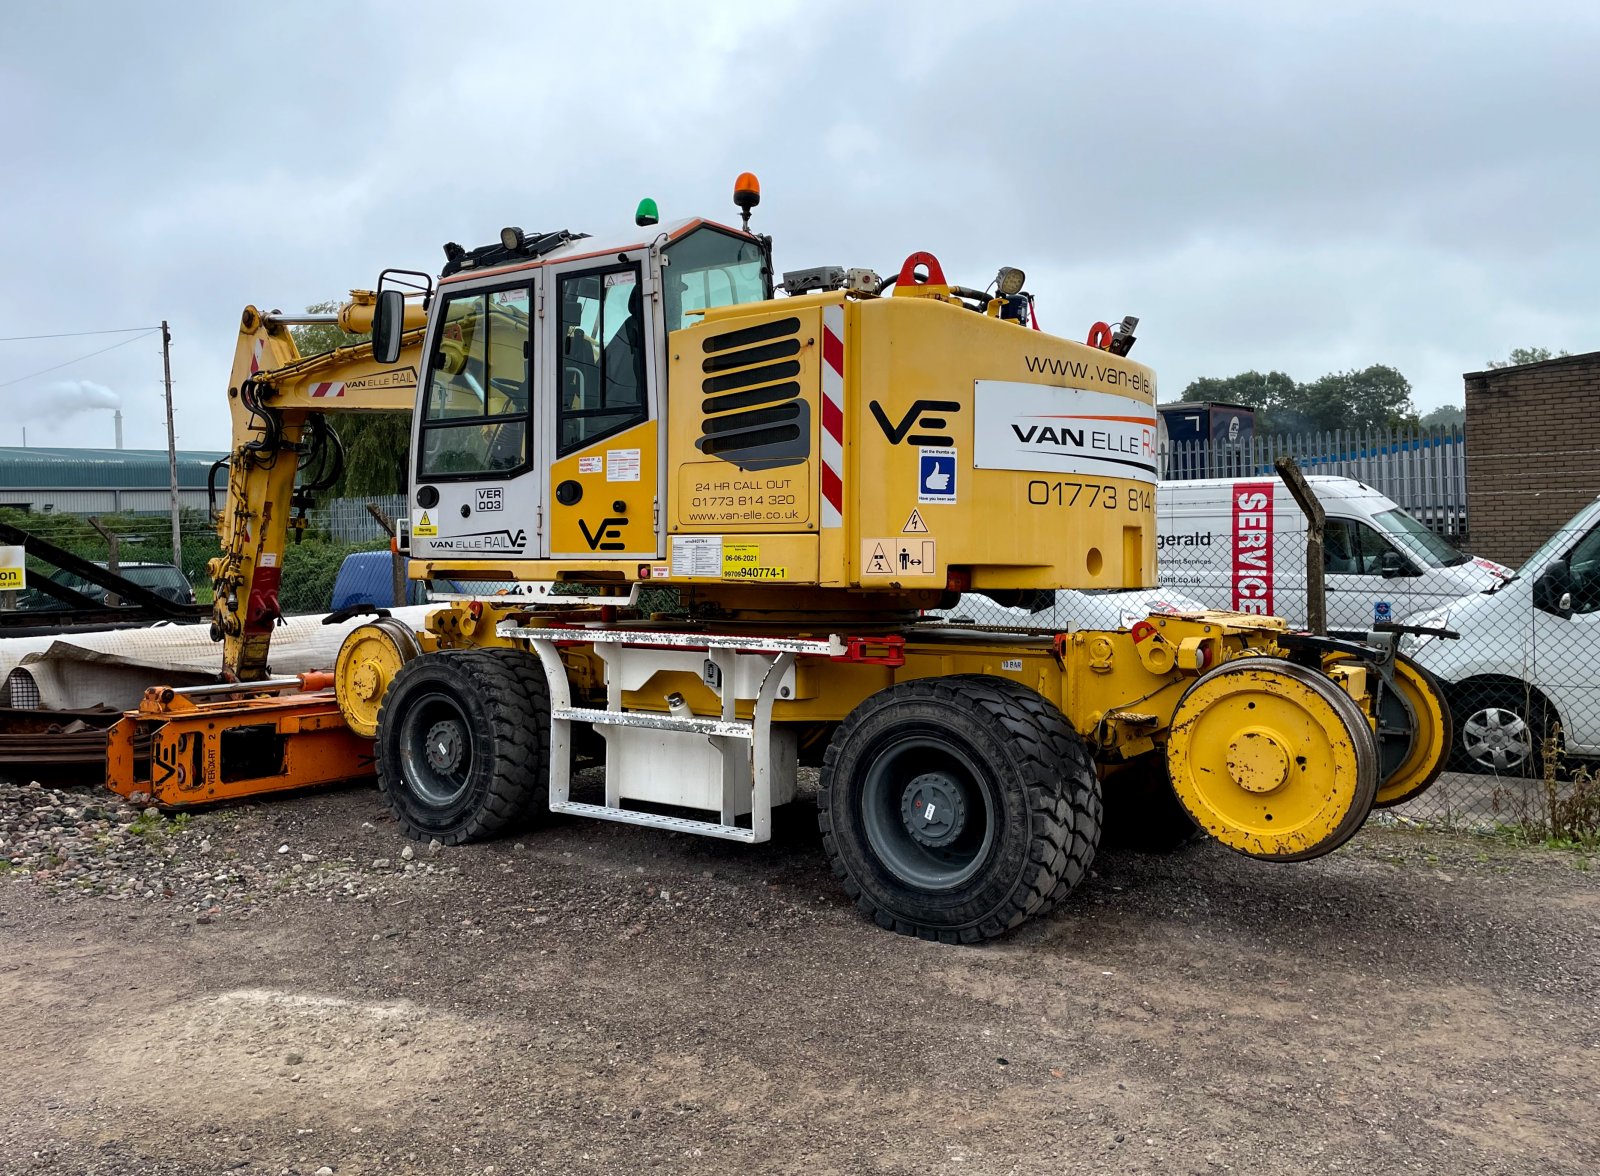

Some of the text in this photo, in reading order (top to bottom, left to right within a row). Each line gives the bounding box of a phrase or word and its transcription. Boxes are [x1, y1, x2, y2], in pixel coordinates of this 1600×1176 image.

[345, 372, 414, 389] VAN ELLE RAIL
[869, 399, 961, 447] VE
[1011, 424, 1084, 447] VAN
[1092, 431, 1139, 455] ELLE
[695, 480, 792, 492] 24 HR CALL OUT
[478, 490, 501, 499] VER
[692, 495, 795, 507] 01773 814 320
[1028, 480, 1117, 510] 01773
[478, 501, 501, 510] 003
[689, 510, 799, 521] www.van-elle.co.uk
[578, 517, 629, 550] VE
[1157, 531, 1211, 549] gerald
[430, 541, 453, 549] VAN
[455, 541, 481, 549] ELLE
[484, 536, 509, 549] RAIL
[725, 554, 757, 562] 06-06-2021
[1237, 492, 1268, 616] SERVICE
[0, 571, 17, 581] on
